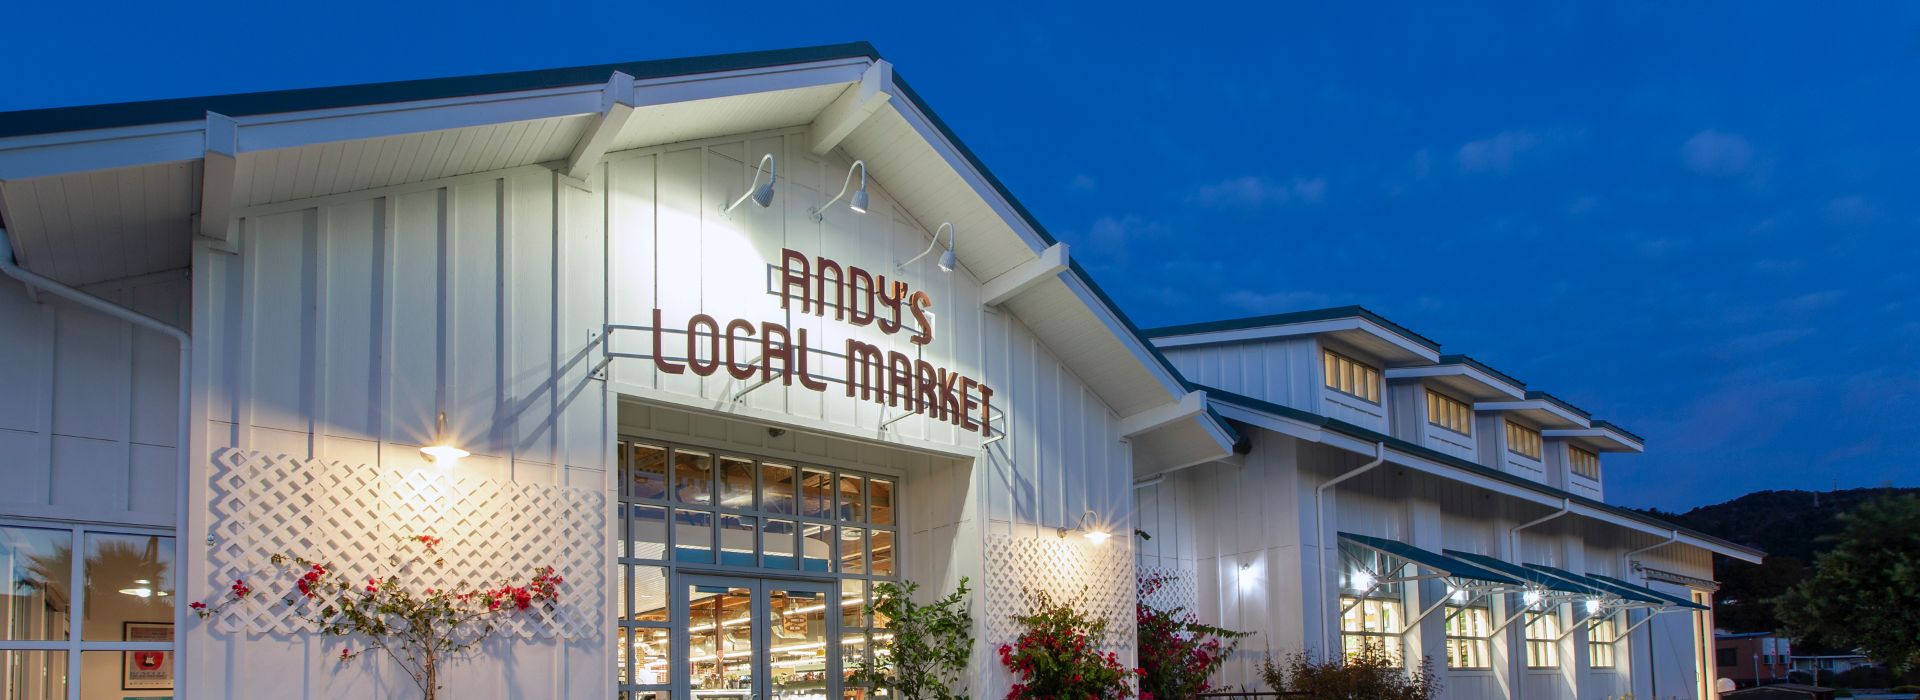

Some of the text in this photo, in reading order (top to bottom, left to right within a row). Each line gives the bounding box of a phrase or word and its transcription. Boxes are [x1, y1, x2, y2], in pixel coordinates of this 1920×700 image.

[780, 248, 932, 345] ANDY'S
[652, 308, 993, 437] LOCAL MARKET
